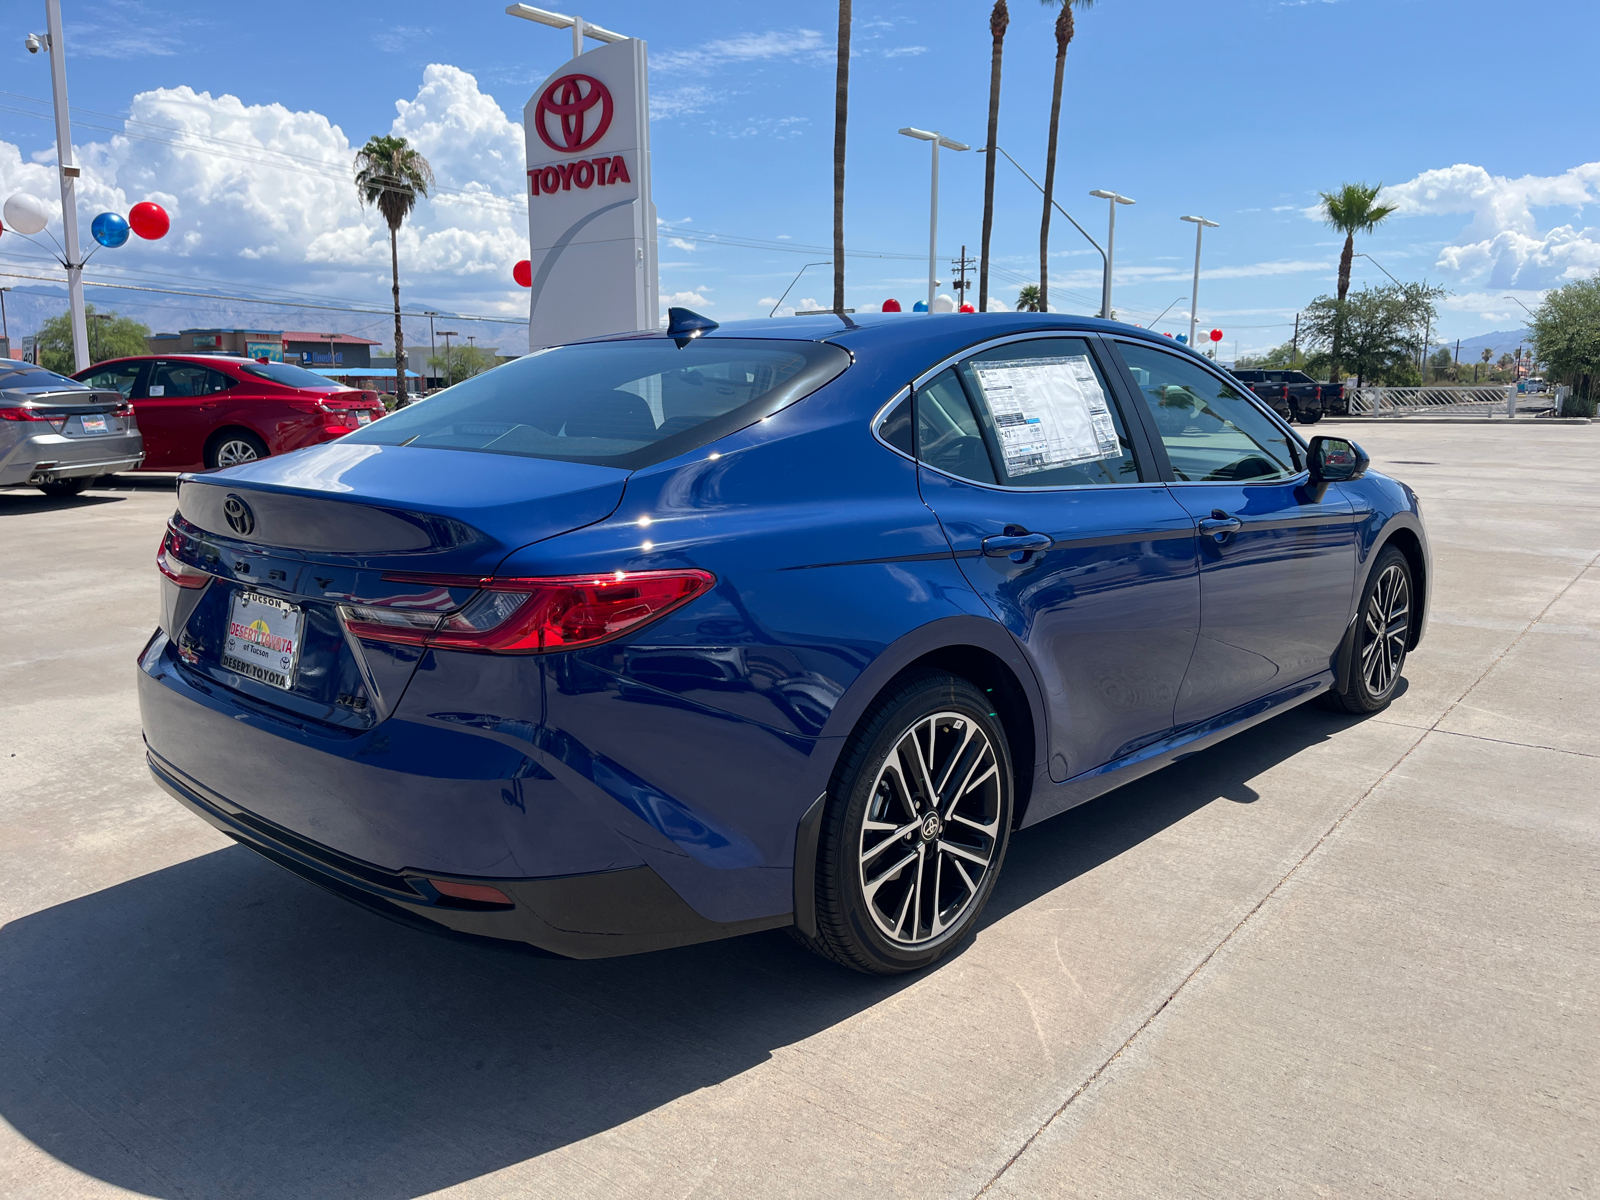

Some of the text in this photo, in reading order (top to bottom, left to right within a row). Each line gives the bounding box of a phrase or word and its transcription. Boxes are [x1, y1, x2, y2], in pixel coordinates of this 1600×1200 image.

[527, 155, 631, 196] TOYOTA
[23, 352, 33, 363] 40
[247, 592, 282, 608] TUCSON
[230, 622, 292, 654] DESERT TOYOTA
[243, 643, 269, 658] of Tucson
[223, 656, 286, 687] DESERT TOYOTA
